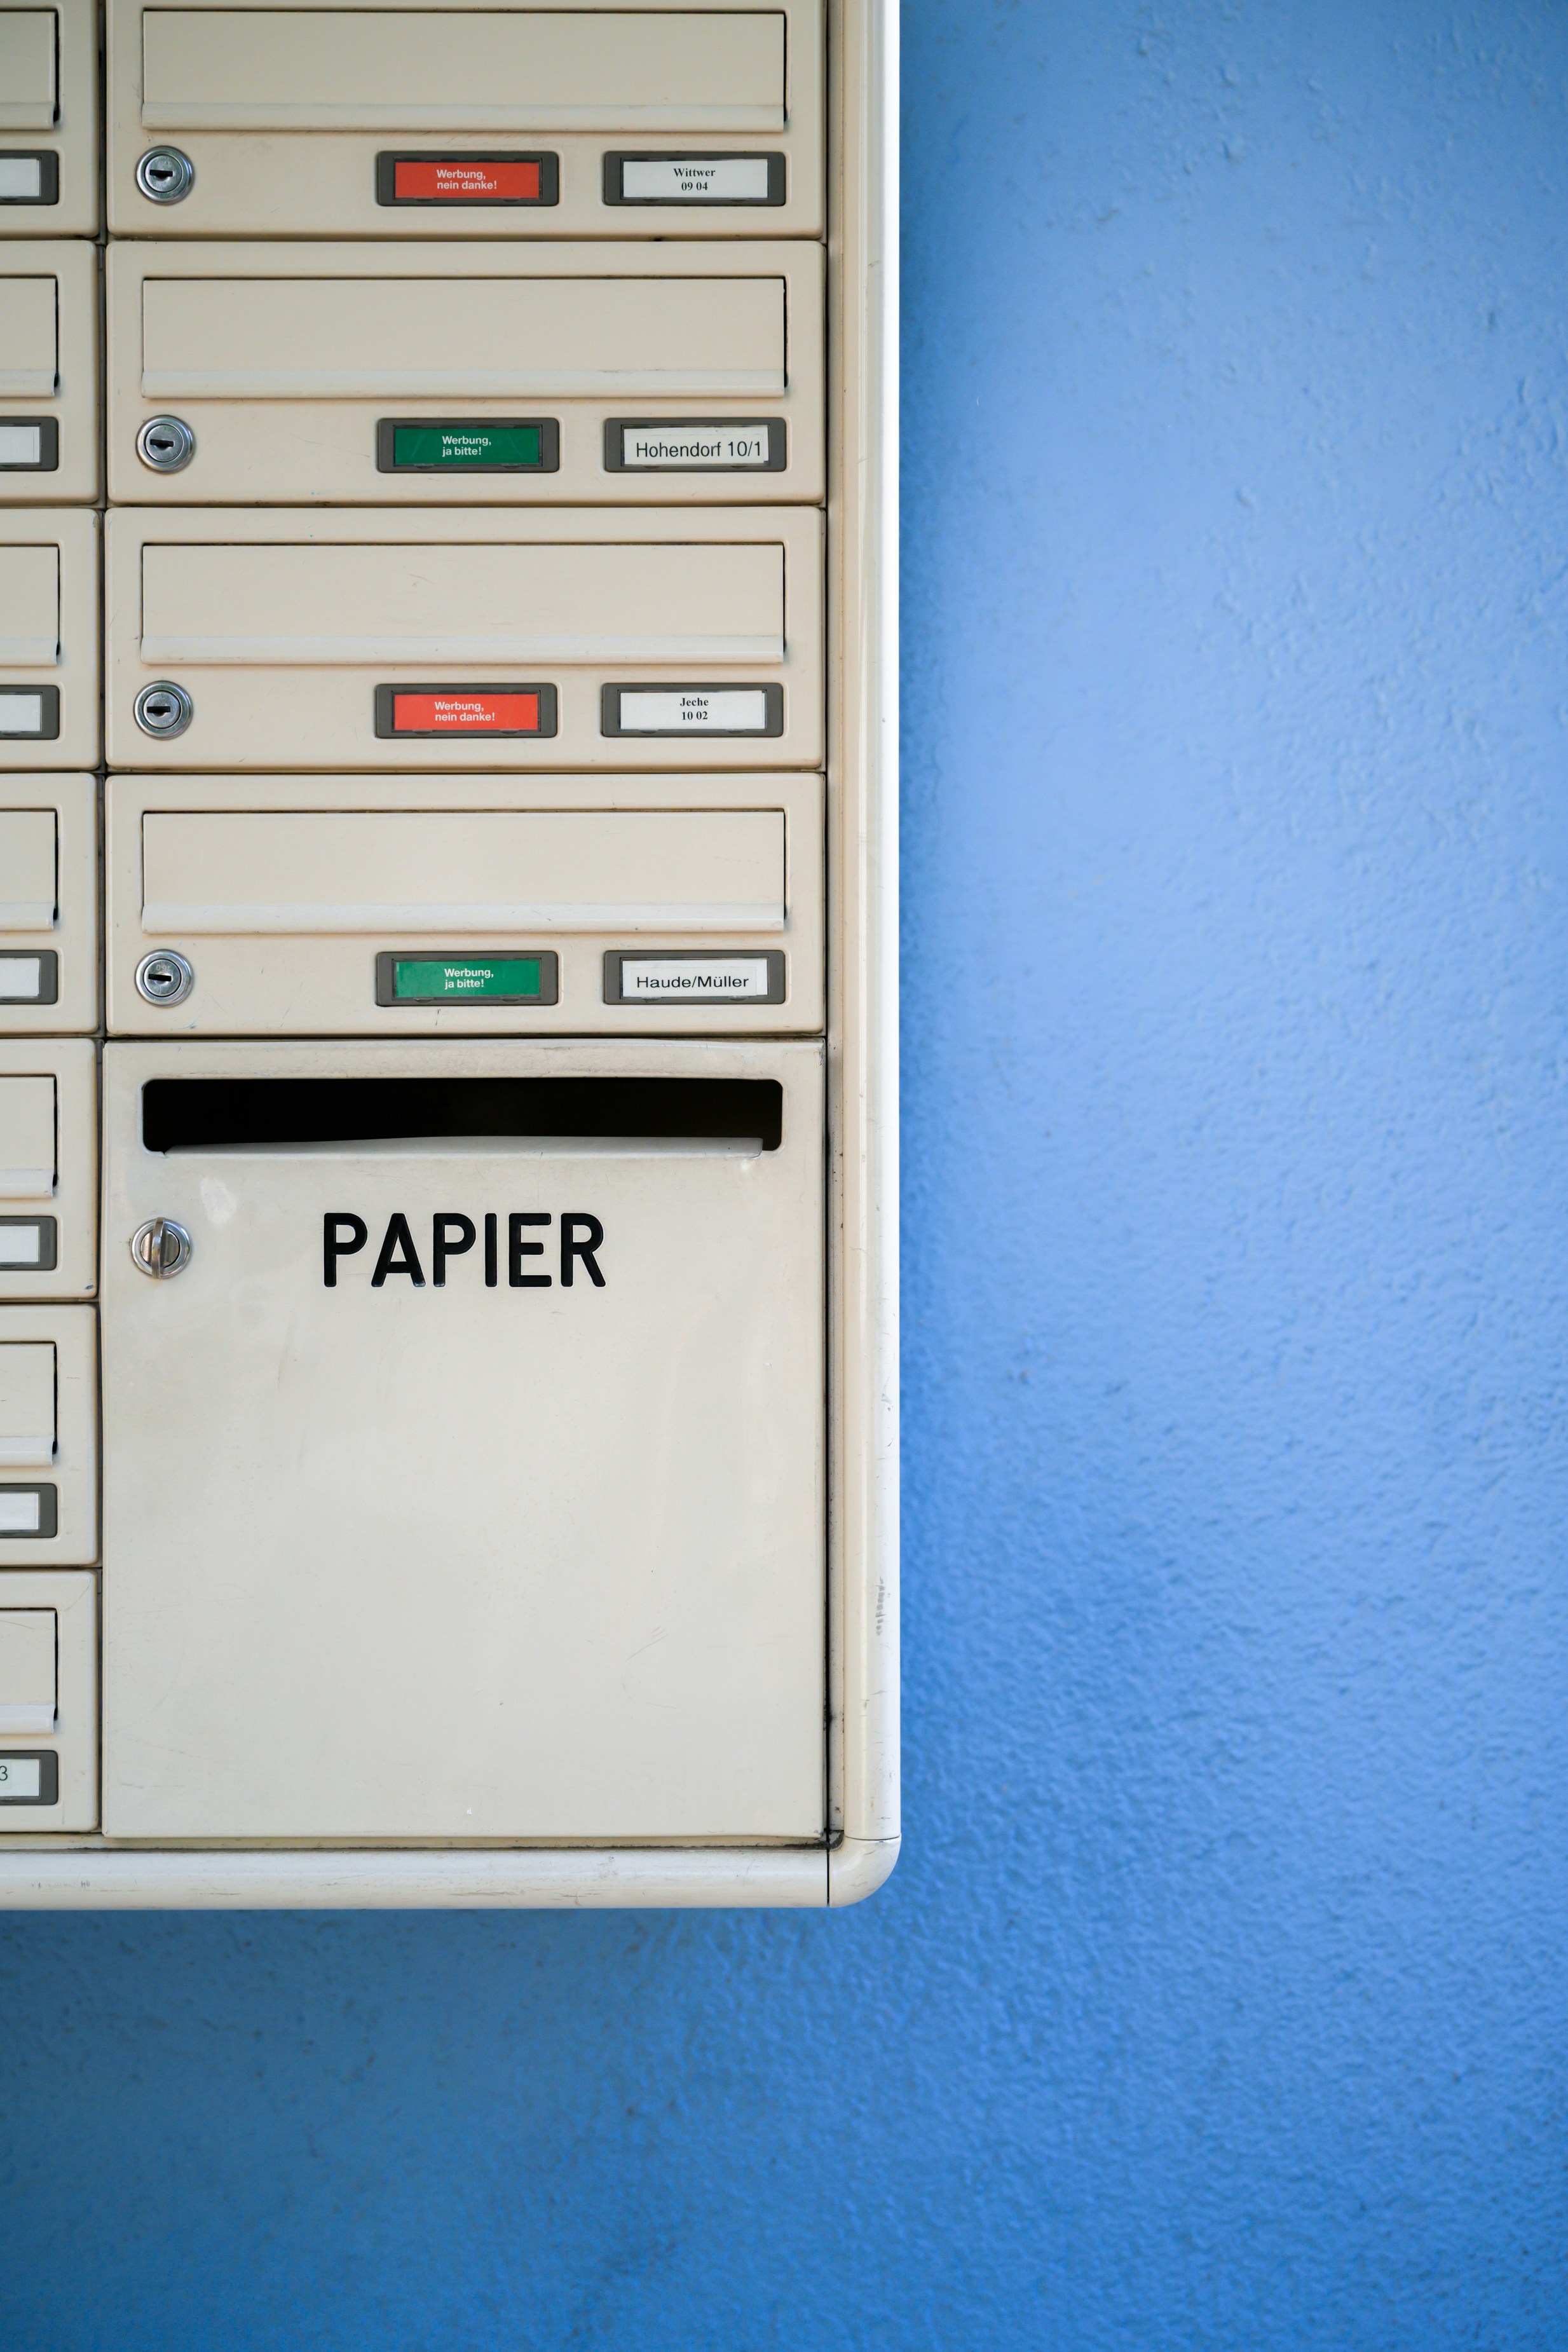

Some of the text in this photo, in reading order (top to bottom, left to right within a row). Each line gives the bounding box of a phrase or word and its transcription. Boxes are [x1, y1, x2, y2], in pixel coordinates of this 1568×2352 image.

[437, 170, 486, 180] Werbung,
[674, 168, 715, 177] Wittwer
[437, 181, 496, 189] nein danke!
[681, 182, 707, 191] 09 04
[442, 436, 491, 446] Werbung,
[442, 447, 481, 457] ja bitte!
[637, 441, 760, 457] Hohendorf 10/1
[435, 702, 484, 712] Werbung,
[680, 698, 708, 706] Jeche
[435, 713, 494, 721] nein danke!
[697, 711, 707, 720] 02
[444, 969, 493, 978] Werbung,
[445, 980, 454, 990] ja
[637, 976, 749, 988] Haude/Müller
[324, 1213, 606, 1287] PAPIER
